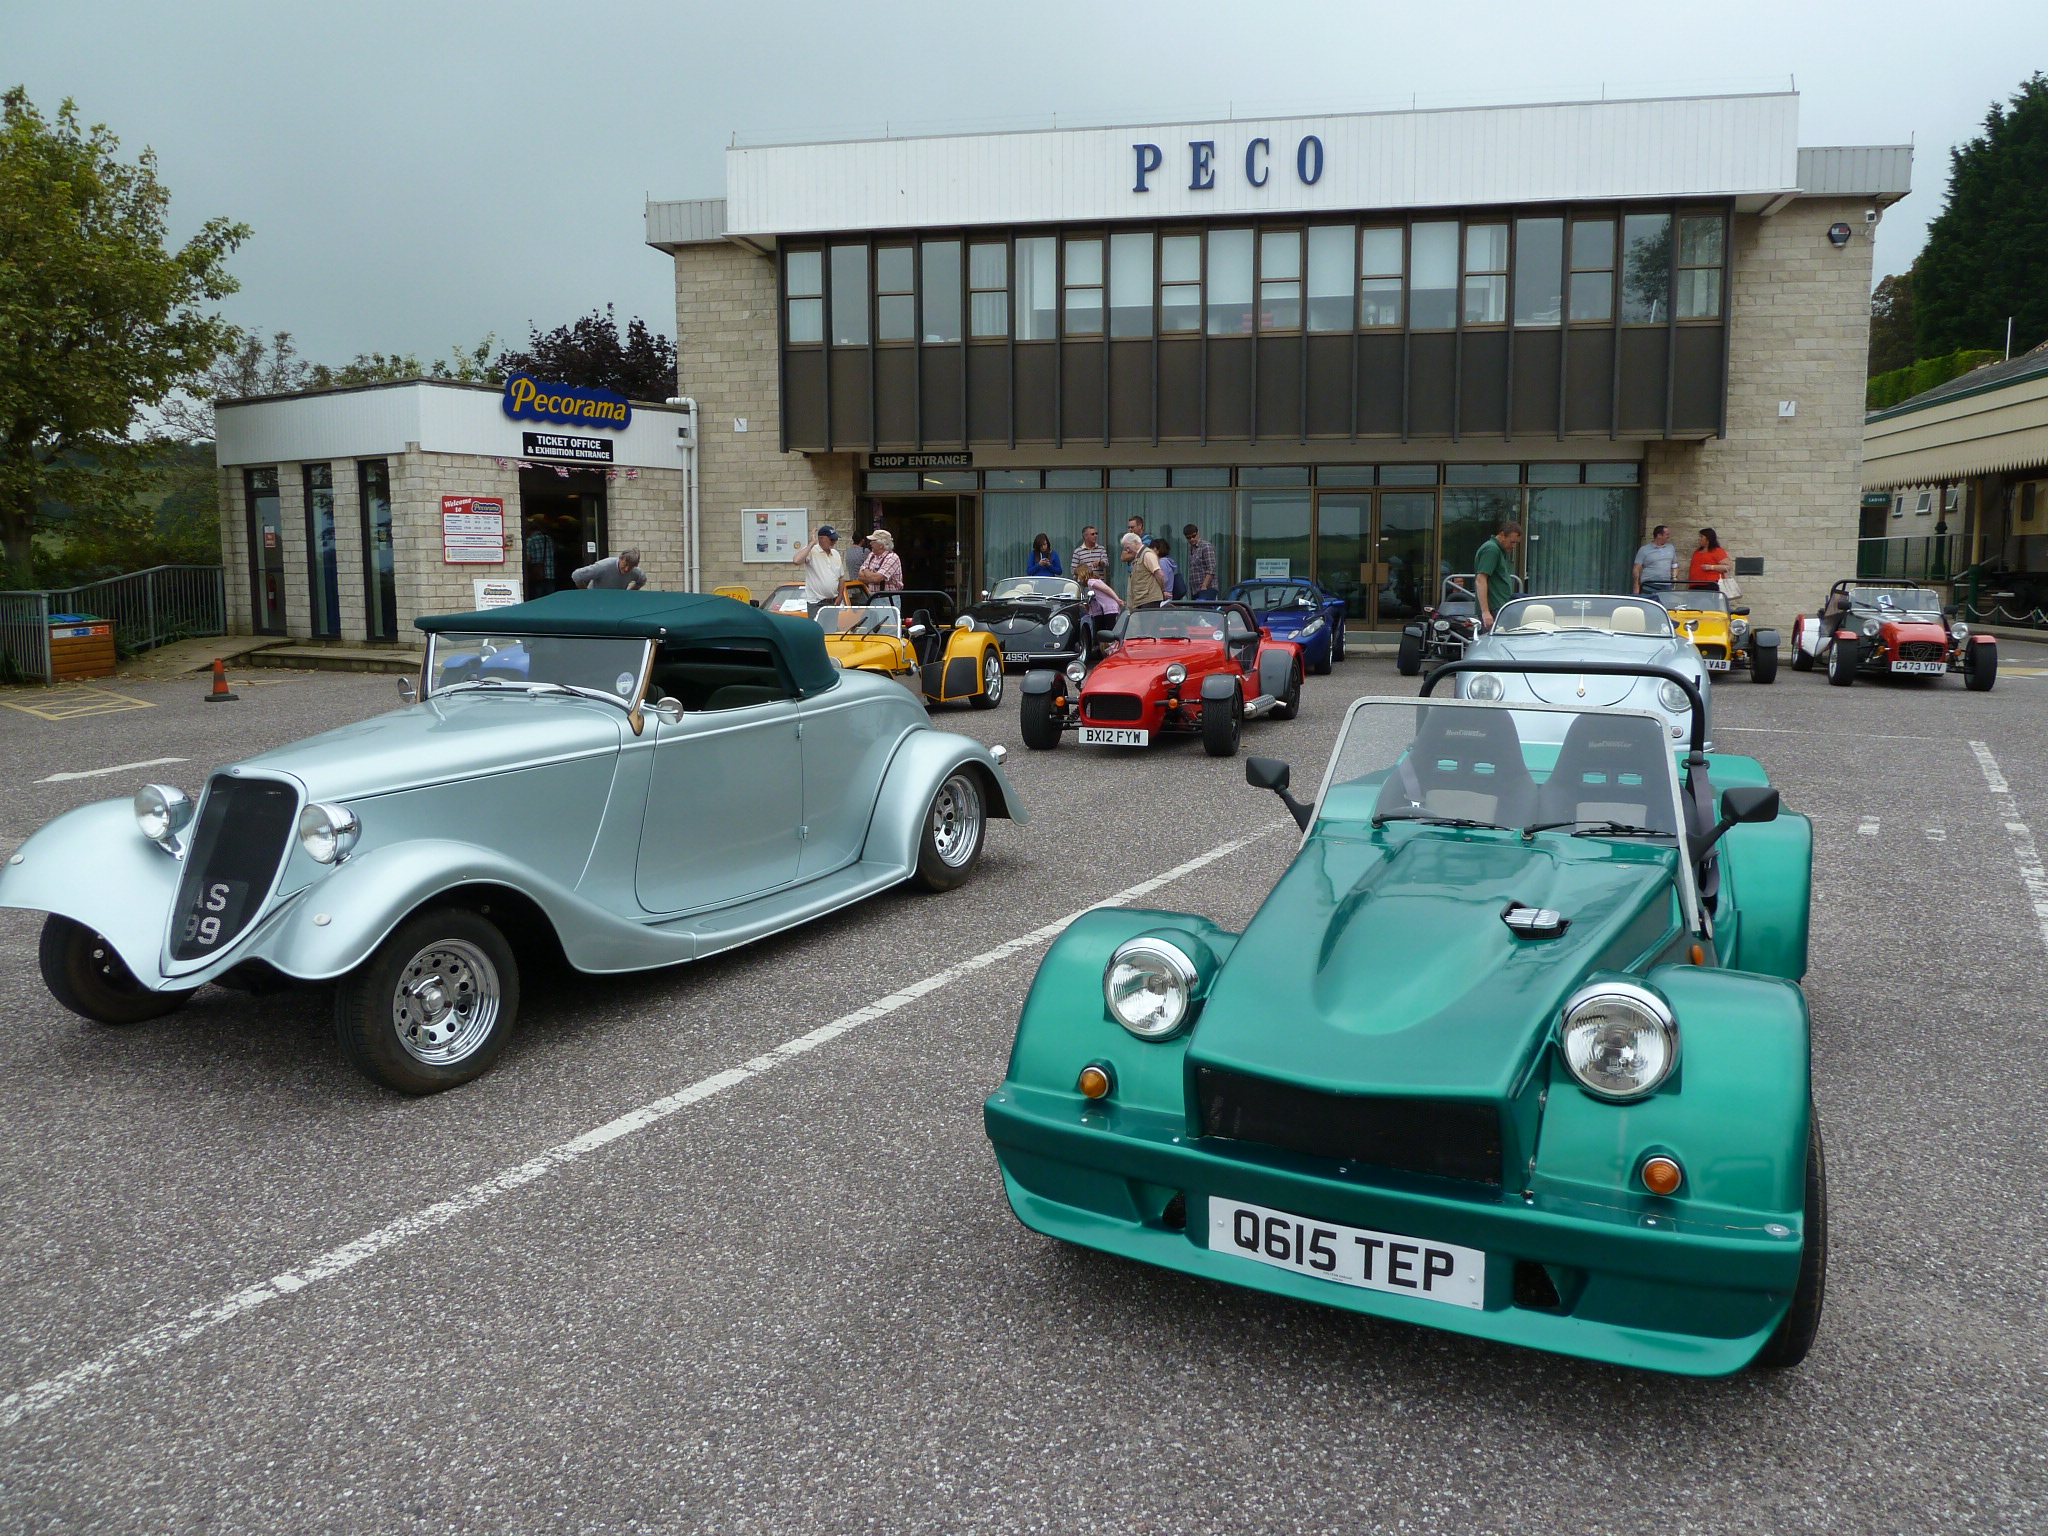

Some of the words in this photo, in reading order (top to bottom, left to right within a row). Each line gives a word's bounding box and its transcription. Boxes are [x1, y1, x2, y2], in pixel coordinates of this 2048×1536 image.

[1132, 135, 1324, 192] PECO
[511, 378, 626, 420] Pecorama
[536, 435, 568, 447] TICKET
[570, 438, 601, 449] OFFICE
[527, 446, 534, 454] &
[535, 446, 574, 456] EXHIBITION
[575, 449, 610, 459] ENTRANCE
[873, 456, 905, 466] SHOP
[908, 455, 967, 465] ENTRANCE
[444, 498, 472, 508] Welcome
[1005, 653, 1028, 661] 495K
[1709, 661, 1727, 669] VAB
[1895, 662, 1921, 671] G473
[1924, 663, 1942, 671] YDV
[1086, 730, 1114, 742] BX12
[1116, 731, 1141, 743] FYW
[1233, 1209, 1337, 1272] Q615
[1354, 1236, 1454, 1291] TEP
